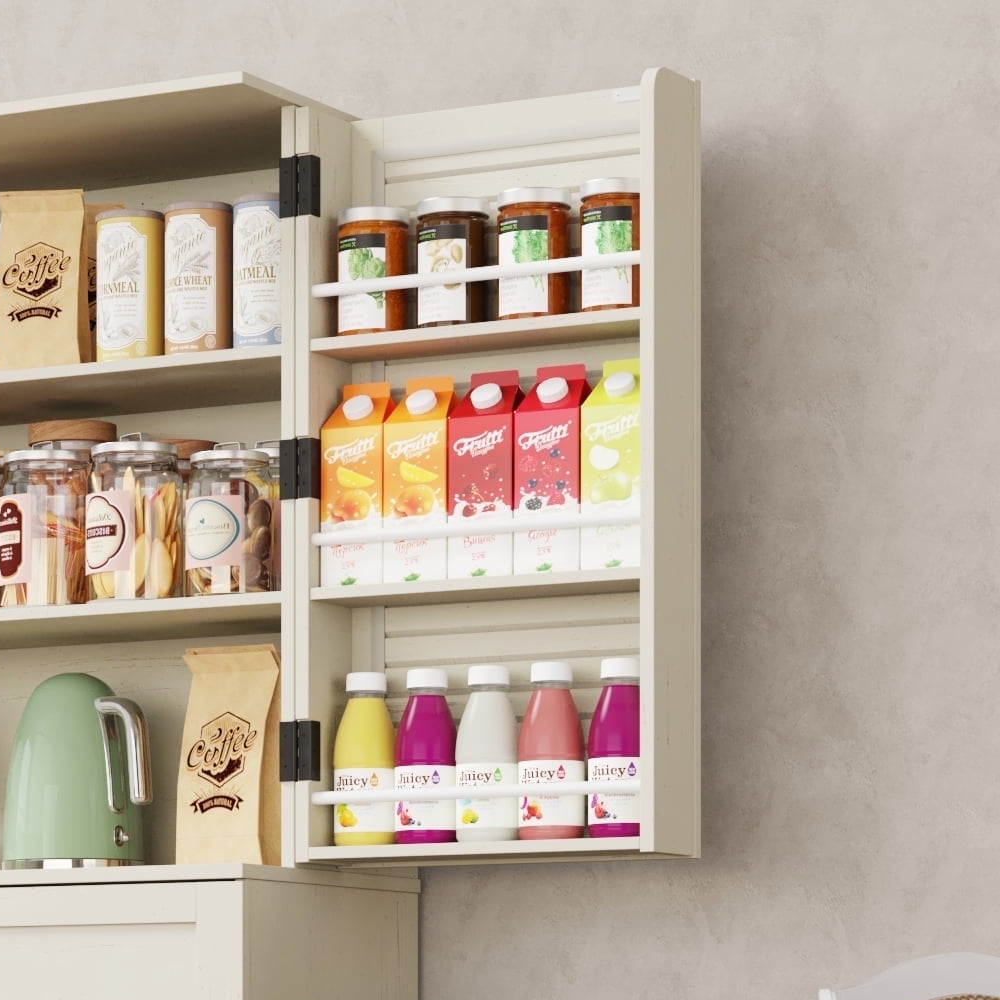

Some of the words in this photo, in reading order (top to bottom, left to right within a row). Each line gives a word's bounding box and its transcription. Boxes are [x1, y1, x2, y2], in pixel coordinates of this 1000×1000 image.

[2, 253, 72, 288] Coffee
[238, 265, 277, 281] ATMEAL
[103, 281, 140, 295] RNMEAL
[183, 275, 213, 286] WHEAT
[453, 425, 507, 456] Frutti
[518, 420, 572, 450] Frutti
[324, 432, 379, 464] Frutti
[387, 428, 442, 459] Frutti
[187, 727, 257, 769] Coffee
[460, 770, 492, 783] Juicy
[522, 768, 555, 780] Juicy
[592, 764, 626, 778] Juicy
[337, 775, 368, 788] Juicy
[399, 773, 430, 785] Juicy
